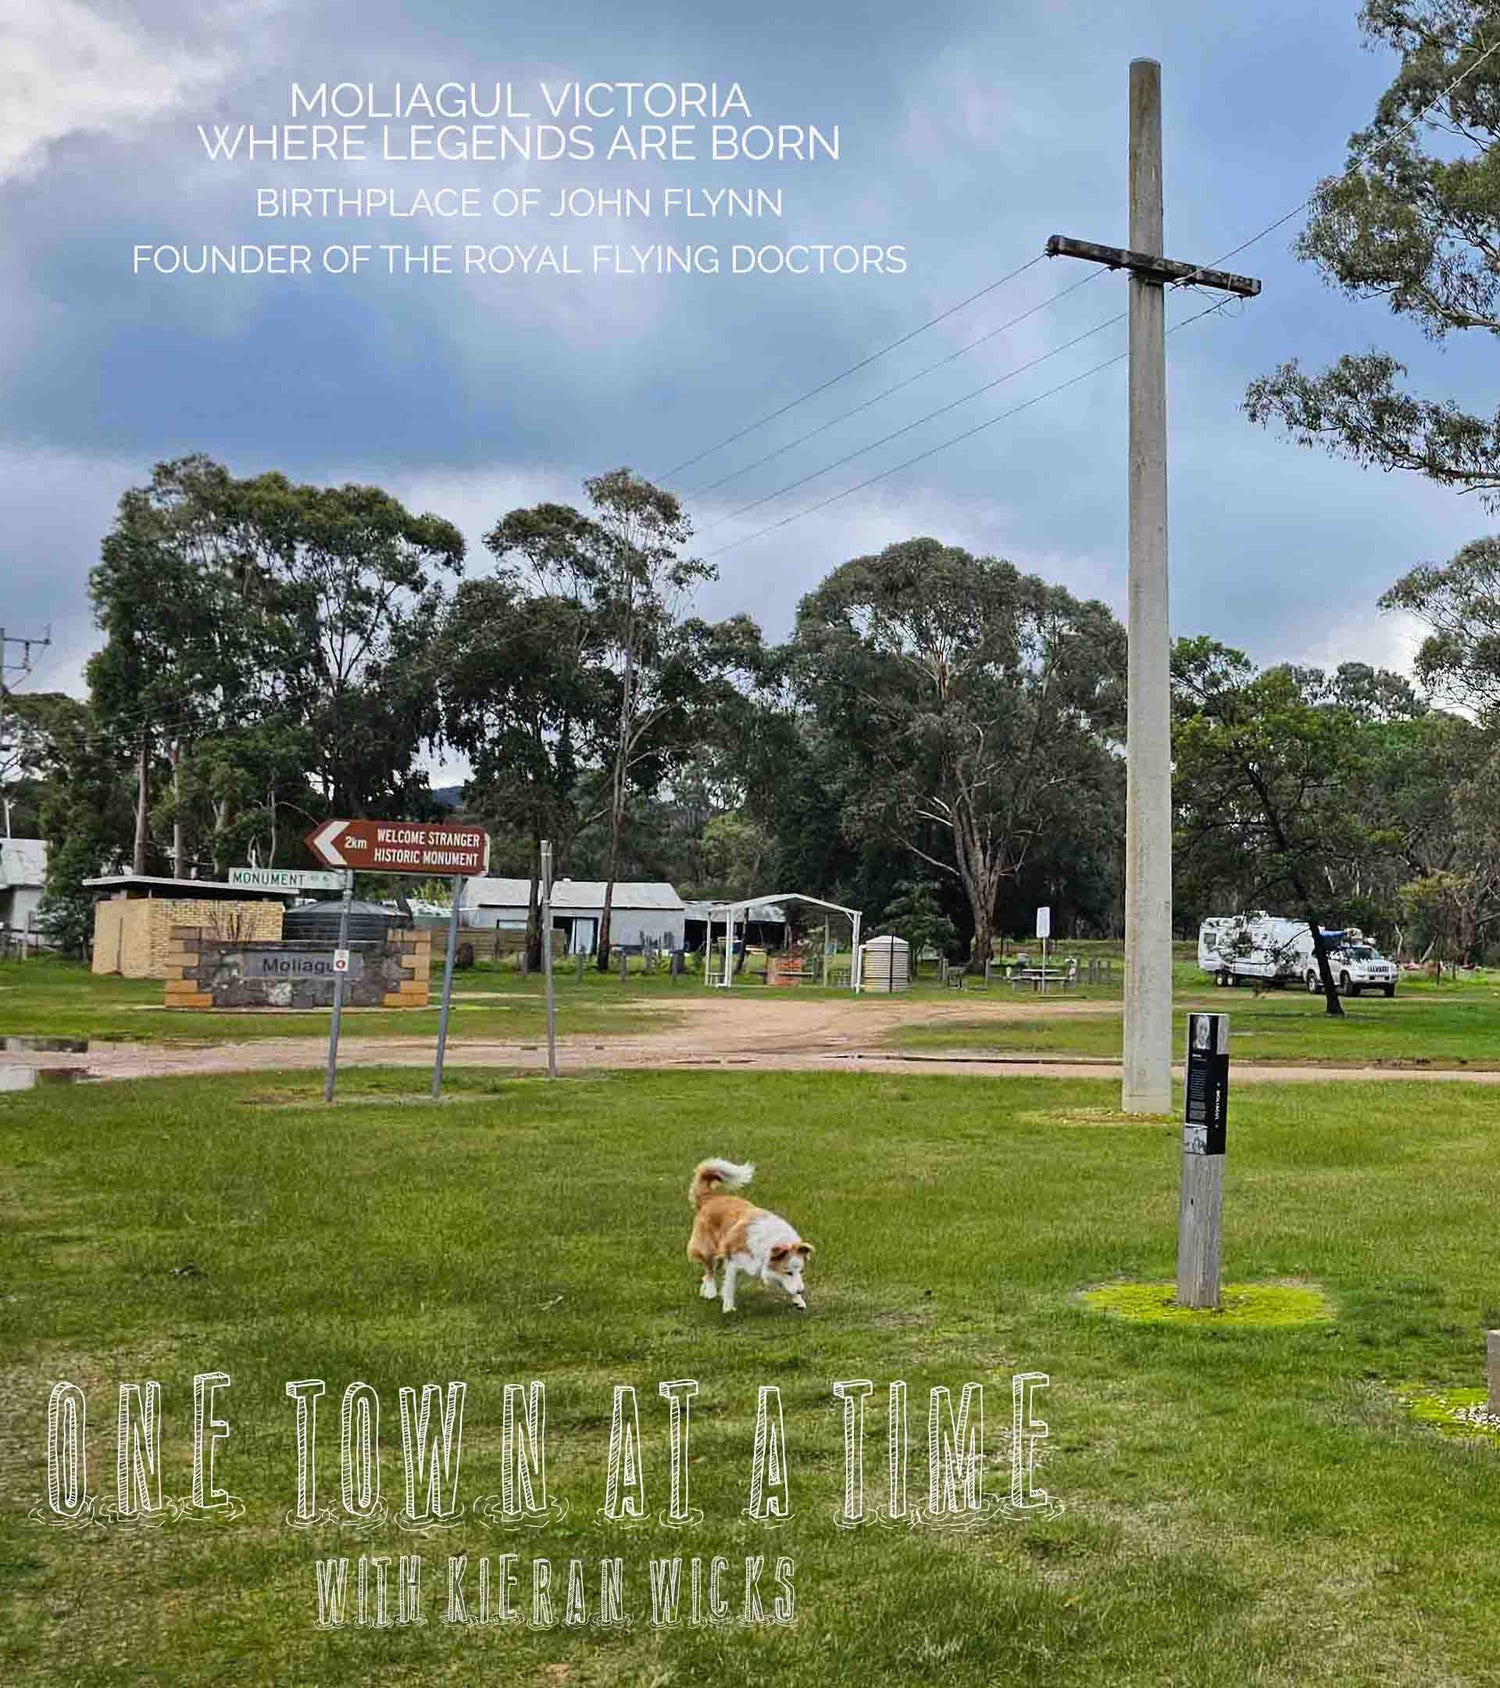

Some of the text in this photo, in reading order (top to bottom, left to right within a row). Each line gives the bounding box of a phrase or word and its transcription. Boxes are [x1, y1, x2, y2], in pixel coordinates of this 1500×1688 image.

[344, 836, 367, 850] 2km
[377, 828, 480, 848] WELCOME STRANGER
[373, 848, 480, 866] HISTORIC MONUMENT
[232, 870, 304, 887] MONUMENT
[262, 957, 335, 975] Moliagu
